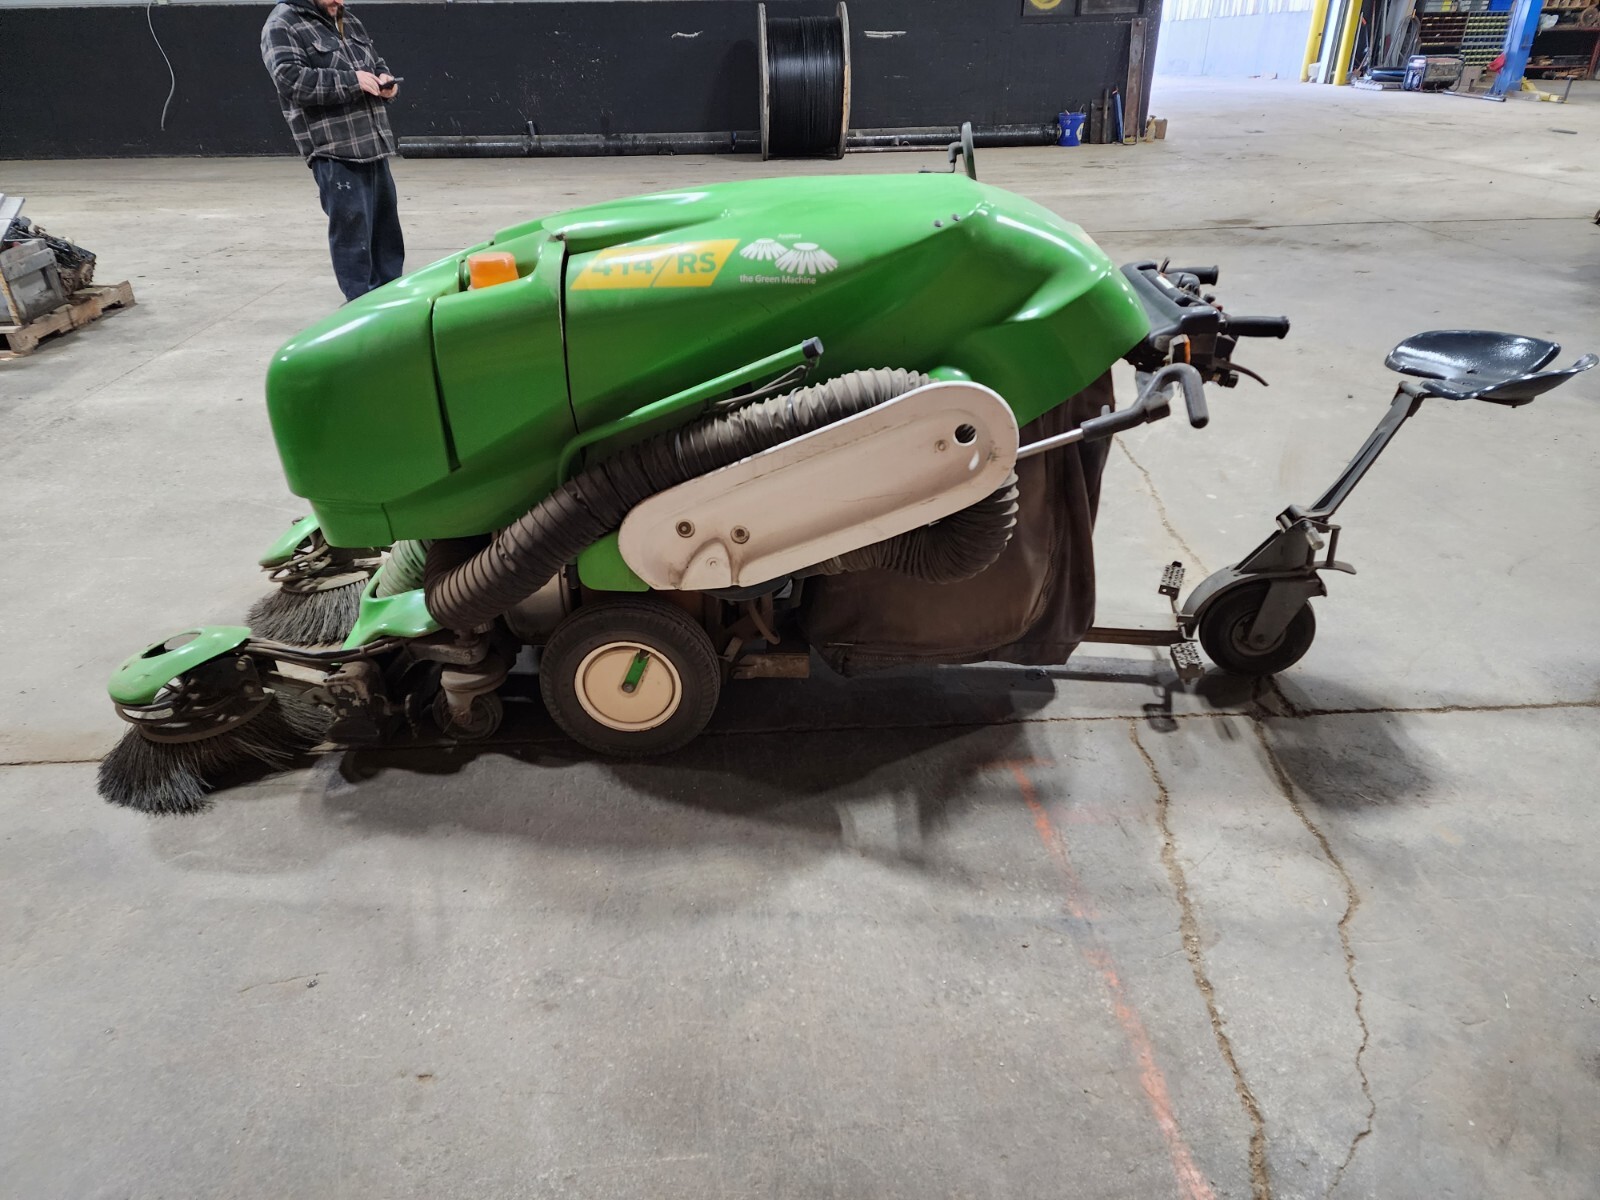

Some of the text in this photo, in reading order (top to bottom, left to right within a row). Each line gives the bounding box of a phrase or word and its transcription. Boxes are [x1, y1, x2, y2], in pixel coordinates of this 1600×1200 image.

[739, 273, 818, 286] the Green Machine
